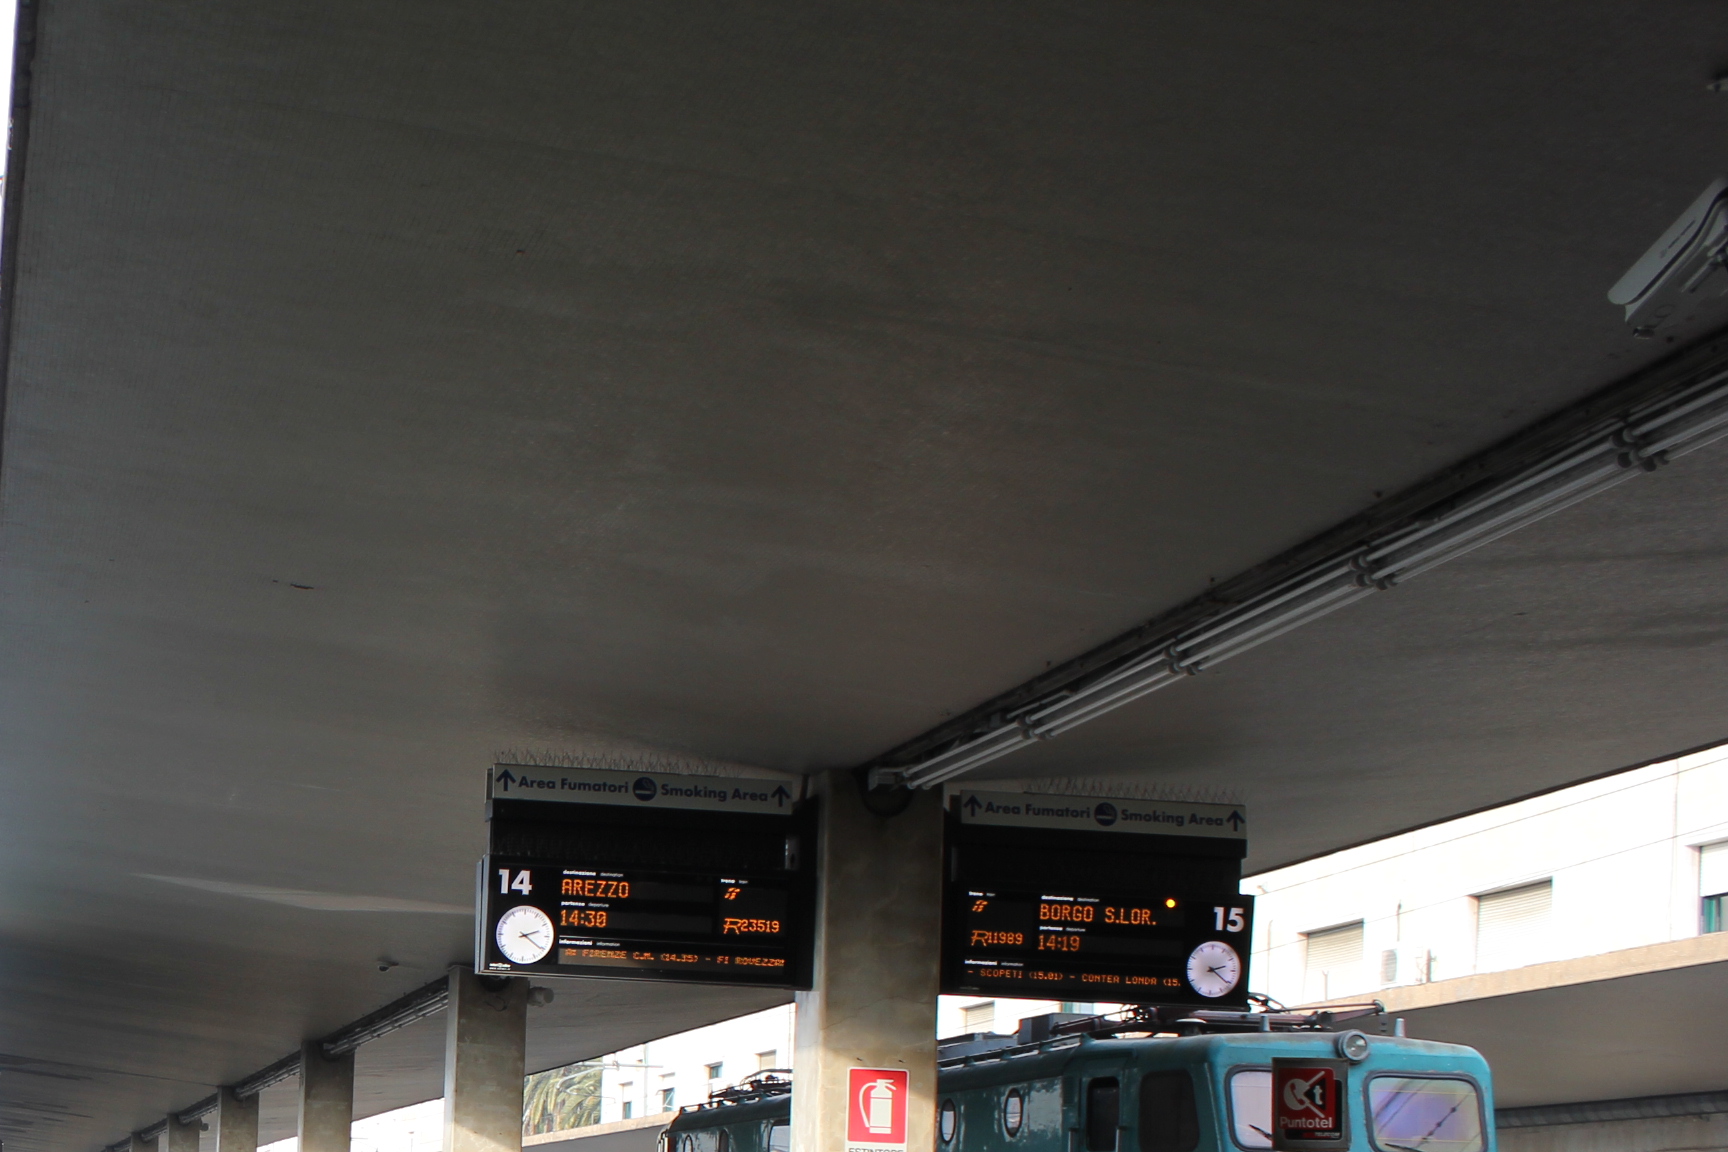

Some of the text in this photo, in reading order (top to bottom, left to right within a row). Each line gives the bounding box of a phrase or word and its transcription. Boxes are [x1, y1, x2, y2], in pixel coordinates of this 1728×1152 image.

[518, 775, 629, 794] Area Fumatori
[660, 784, 768, 802] Smoking Area
[984, 801, 1090, 819] Area Fumatori
[1121, 809, 1223, 827] Smoking Area
[498, 869, 533, 896] 14
[561, 878, 630, 898] AREZZO
[560, 909, 607, 928] 14:30
[1039, 903, 1157, 925] BORGO S.LOR.
[1213, 906, 1245, 933] 15
[723, 917, 780, 935] R23519
[559, 938, 593, 946] informazioni
[971, 930, 1024, 946] R11989
[1037, 934, 1080, 951] 14:19
[581, 948, 628, 960] FIRENZE
[980, 968, 1023, 979] SCOPETI
[1125, 977, 1157, 985] LONDA
[1279, 1116, 1333, 1128] Puntotel
